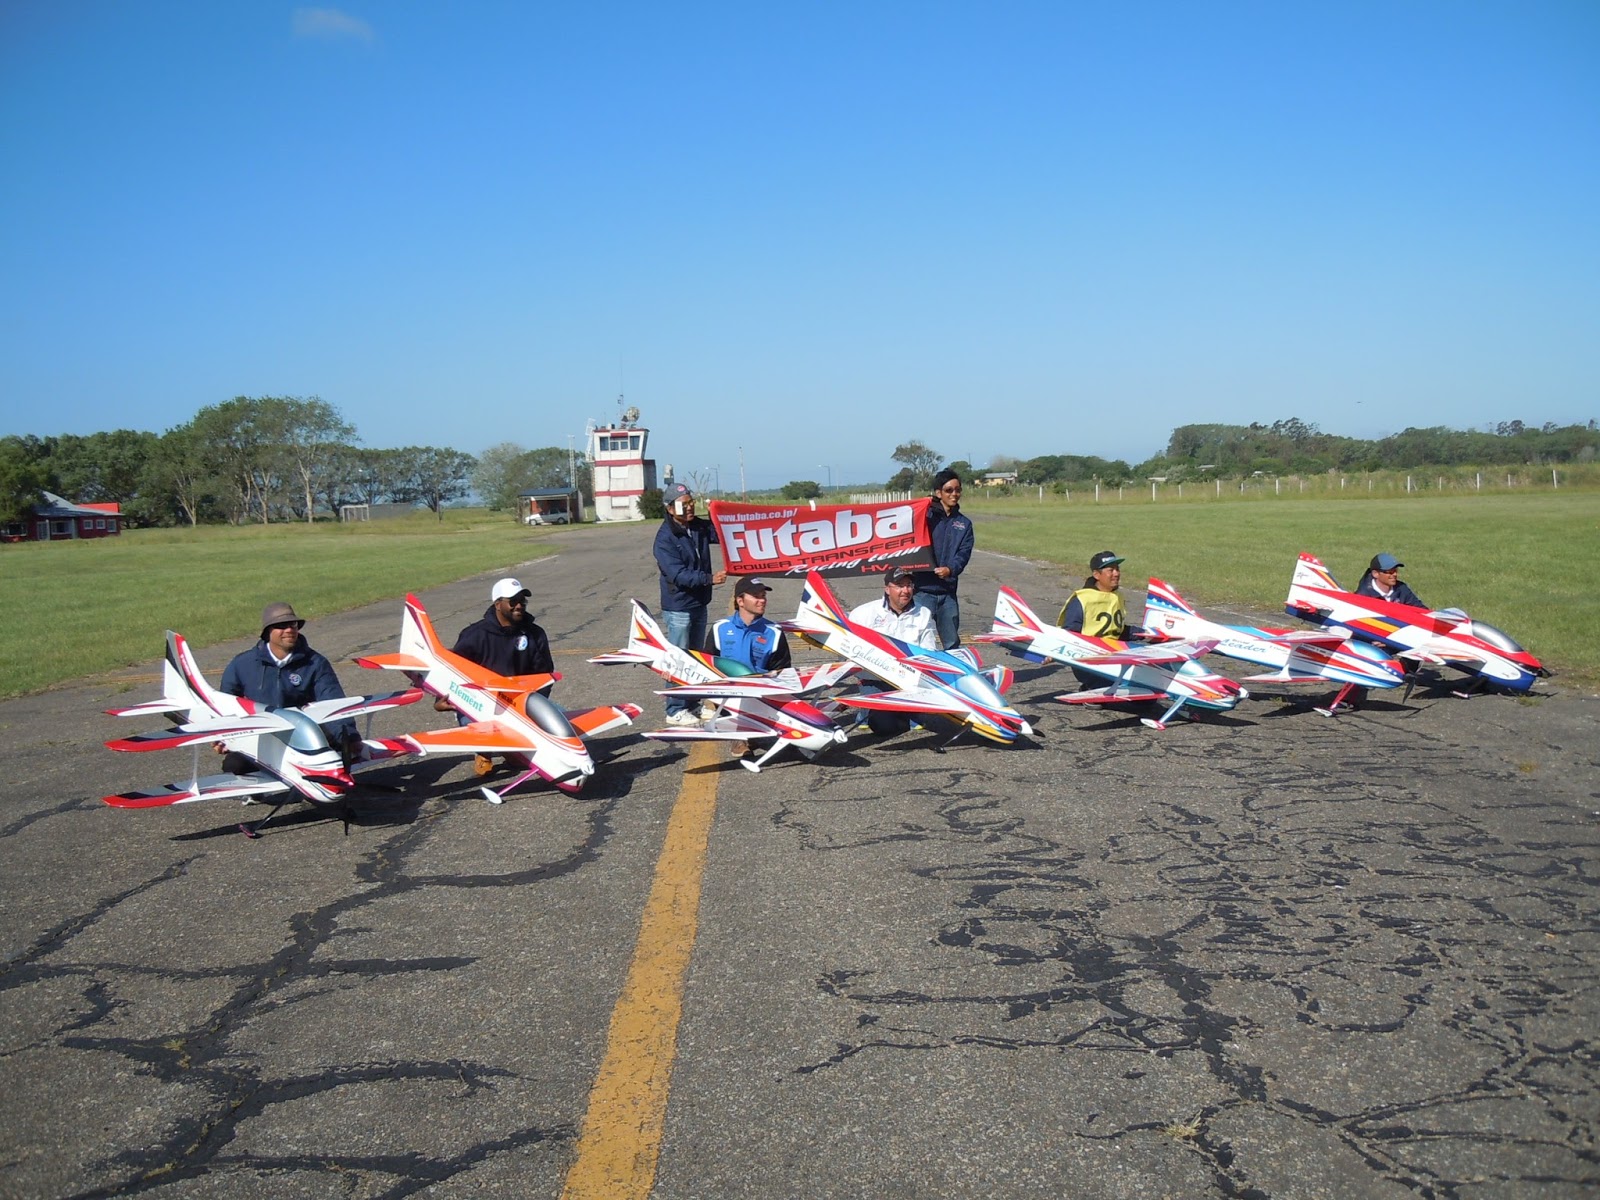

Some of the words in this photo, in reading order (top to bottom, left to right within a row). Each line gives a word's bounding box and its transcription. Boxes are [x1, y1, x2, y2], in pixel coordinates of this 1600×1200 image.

[720, 505, 914, 562] Futaba
[733, 560, 792, 571] POWER
[797, 536, 915, 563] TRANSFER
[785, 558, 862, 576] Racing
[867, 545, 922, 562] team
[1095, 609, 1123, 637] 29
[1220, 638, 1267, 653] Leader
[449, 681, 484, 712] Element
